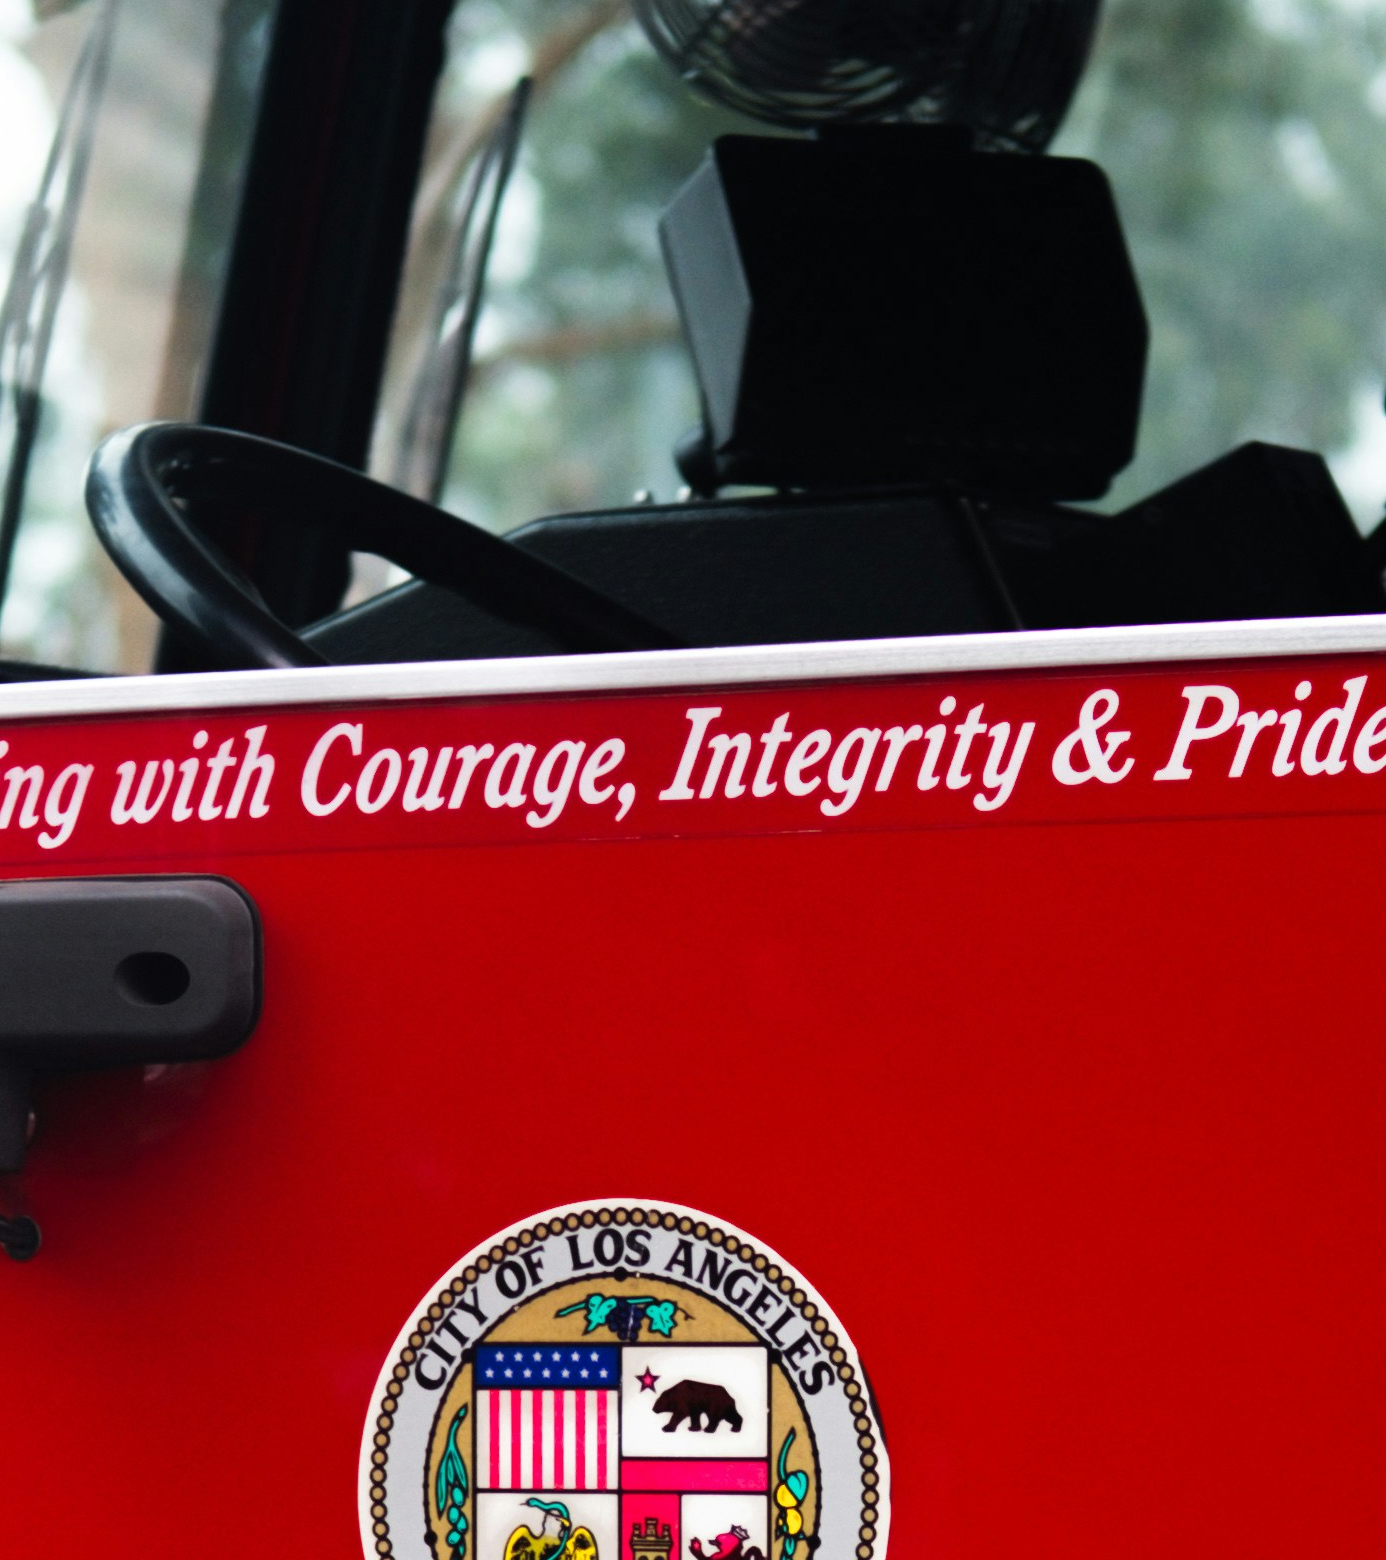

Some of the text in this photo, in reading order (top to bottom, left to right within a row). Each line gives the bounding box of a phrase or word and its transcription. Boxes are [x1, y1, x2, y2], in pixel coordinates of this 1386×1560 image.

[110, 724, 275, 825] with
[299, 722, 636, 829] Courage,
[658, 695, 1036, 817] Integrity
[1051, 688, 1136, 786] &
[413, 1227, 836, 1397] CITY OF LOS ANGELES
